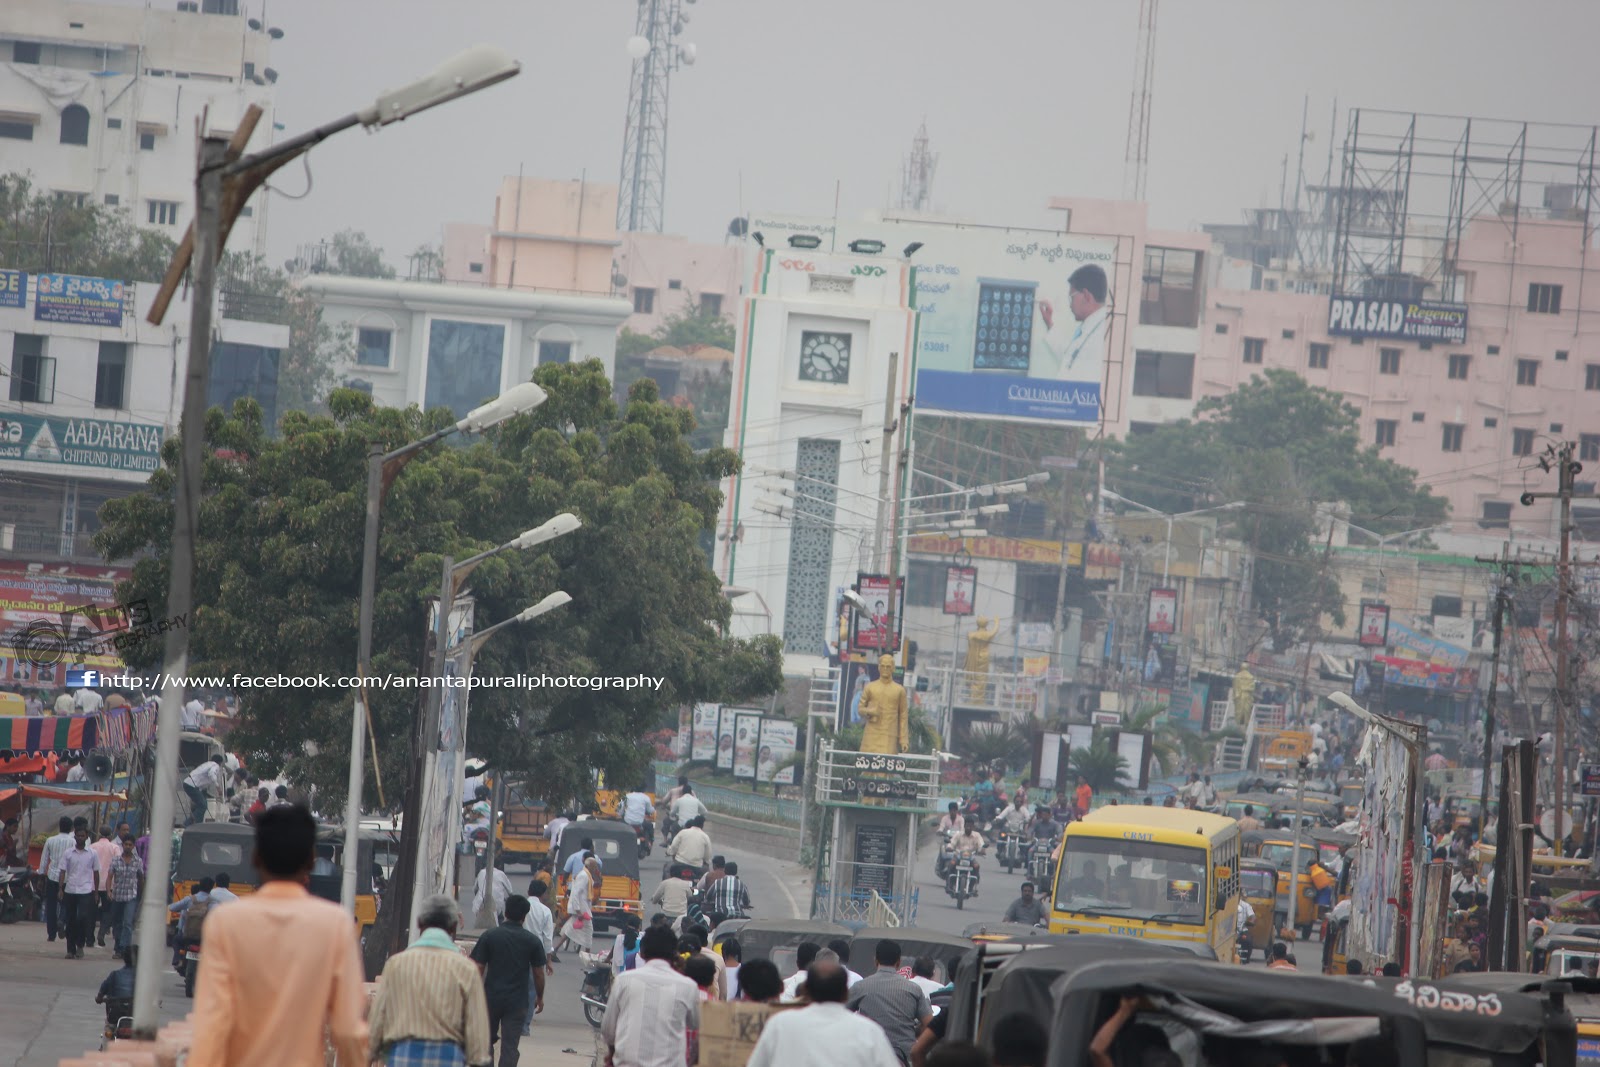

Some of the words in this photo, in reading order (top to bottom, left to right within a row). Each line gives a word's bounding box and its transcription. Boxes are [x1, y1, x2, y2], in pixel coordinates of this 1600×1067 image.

[1329, 299, 1403, 332] PRASAD
[1406, 304, 1465, 326] Regency
[1403, 322, 1416, 336] A/C
[1417, 324, 1442, 337] BUDGET
[1443, 326, 1465, 339] LODGE
[63, 419, 160, 452] AADARANA
[63, 449, 108, 465] CHITFUND
[110, 454, 122, 468] (P)
[123, 455, 158, 470] LIMITED
[855, 755, 906, 772] మహాకవి
[1123, 831, 1154, 841] CRMT
[1109, 925, 1147, 937] CRMT
